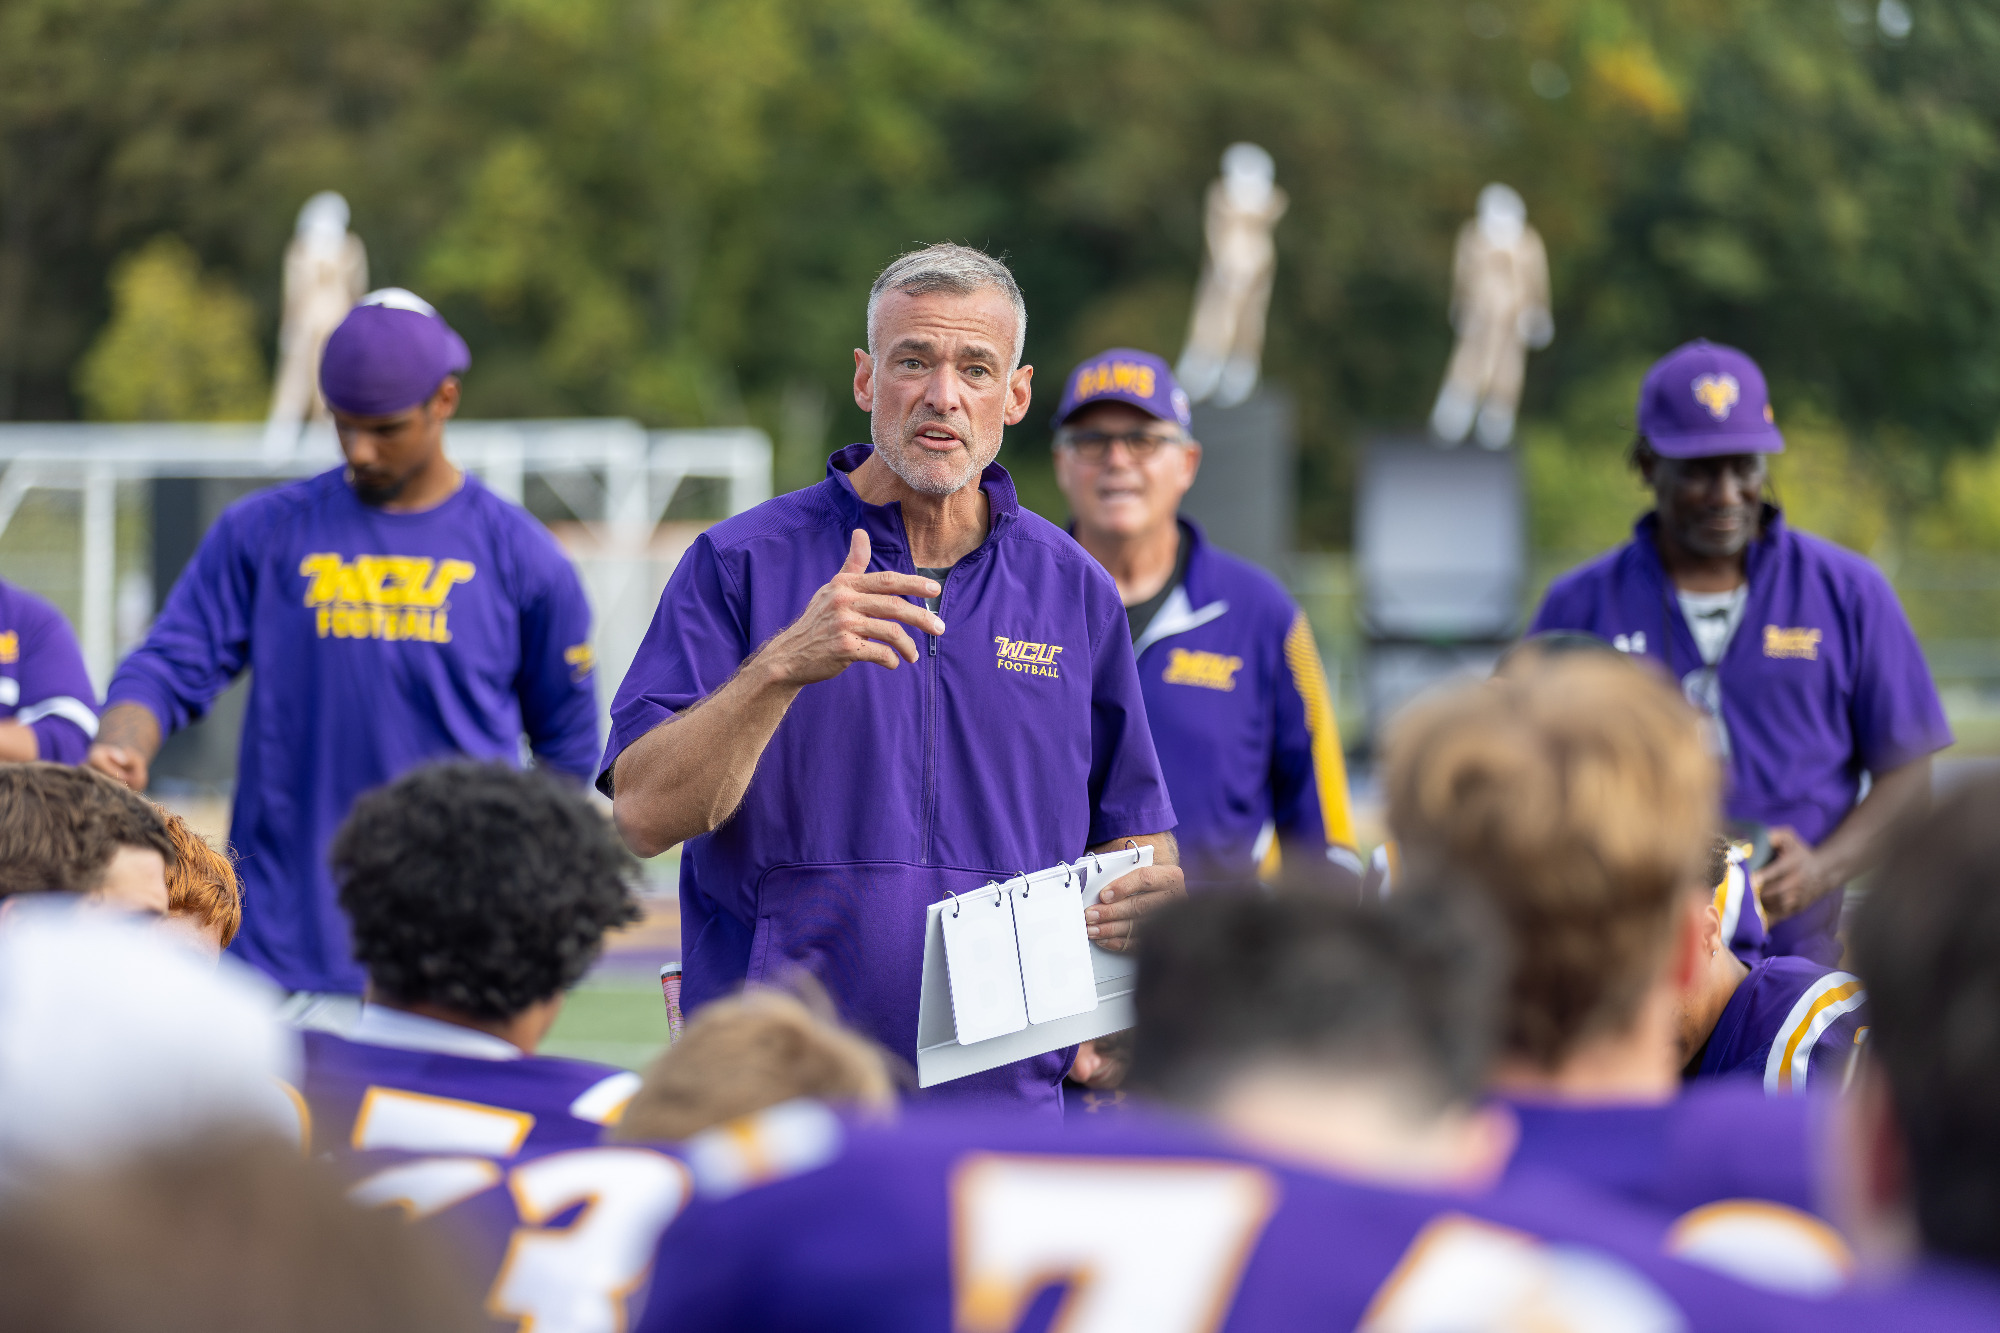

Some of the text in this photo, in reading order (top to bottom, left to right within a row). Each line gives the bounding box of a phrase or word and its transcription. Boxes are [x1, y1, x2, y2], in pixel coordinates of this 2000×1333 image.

[300, 552, 476, 609] WCU
[316, 606, 453, 644] FOOTBALL
[995, 636, 1063, 665] WCU
[997, 658, 1059, 679] FOOTBALL
